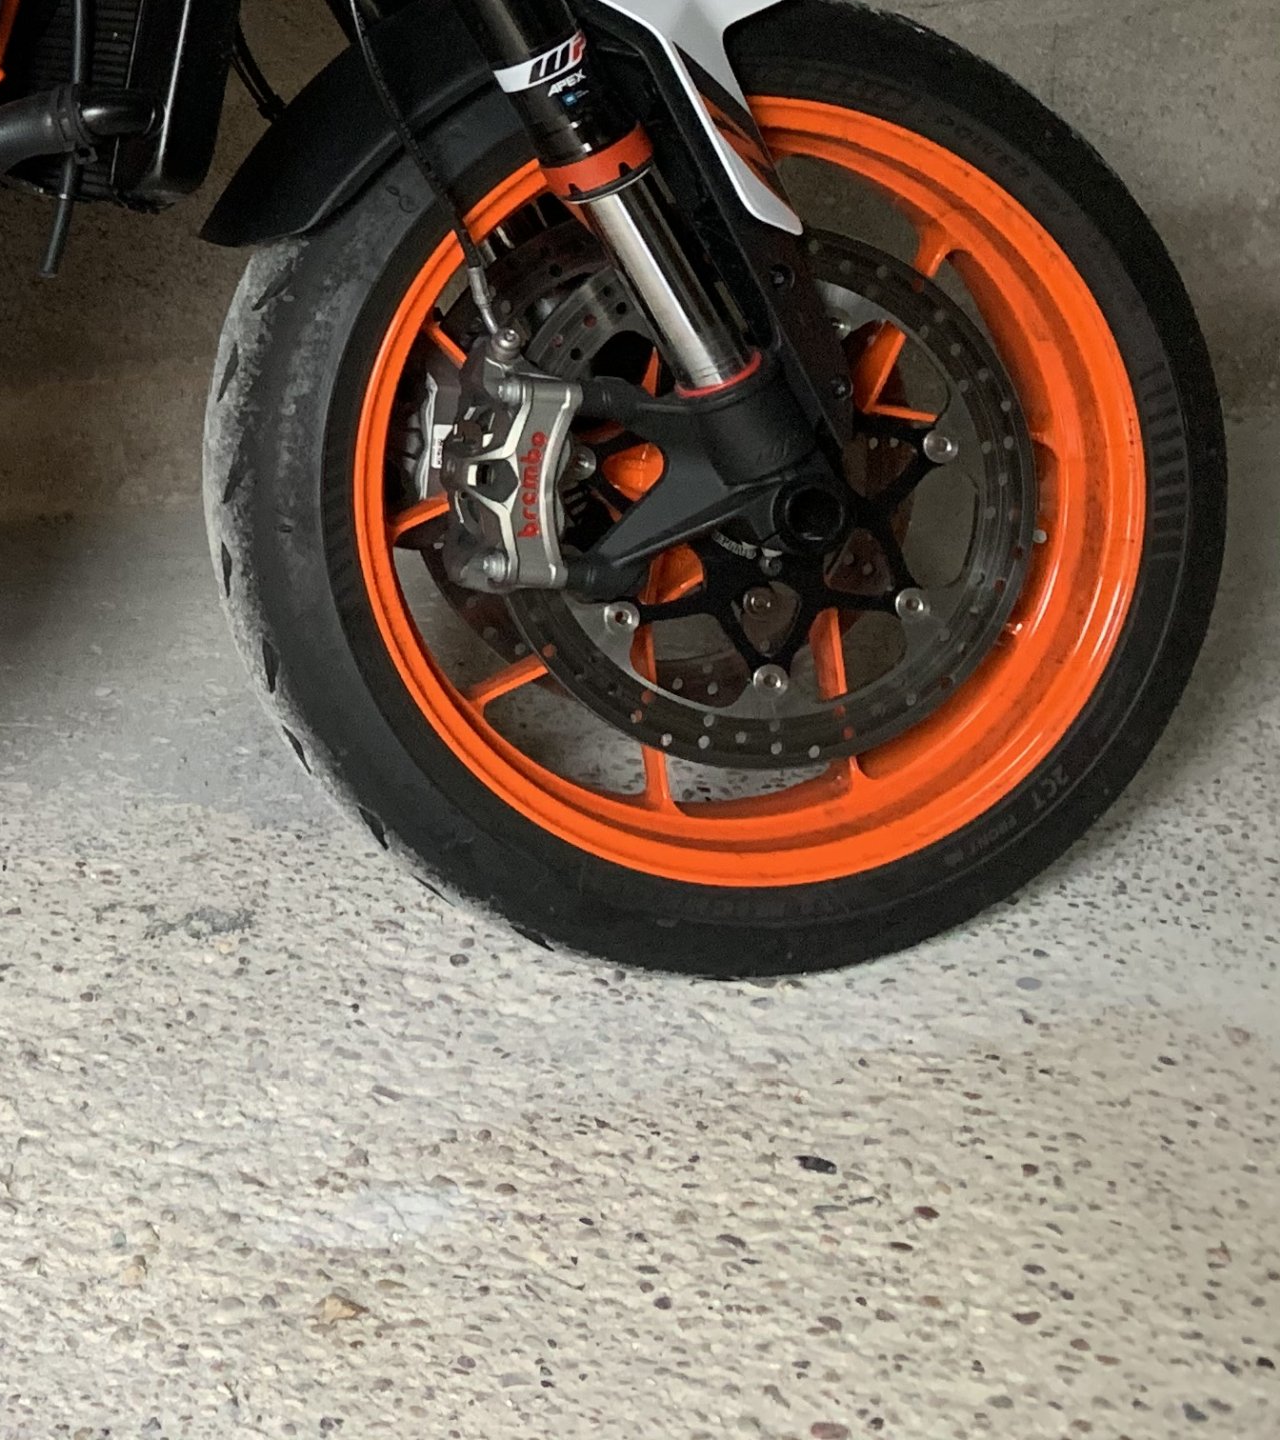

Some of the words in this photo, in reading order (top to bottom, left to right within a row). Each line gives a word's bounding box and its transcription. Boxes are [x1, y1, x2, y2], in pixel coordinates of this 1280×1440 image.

[528, 30, 586, 85] WP
[547, 68, 587, 98] APEX
[517, 431, 547, 539] brembo
